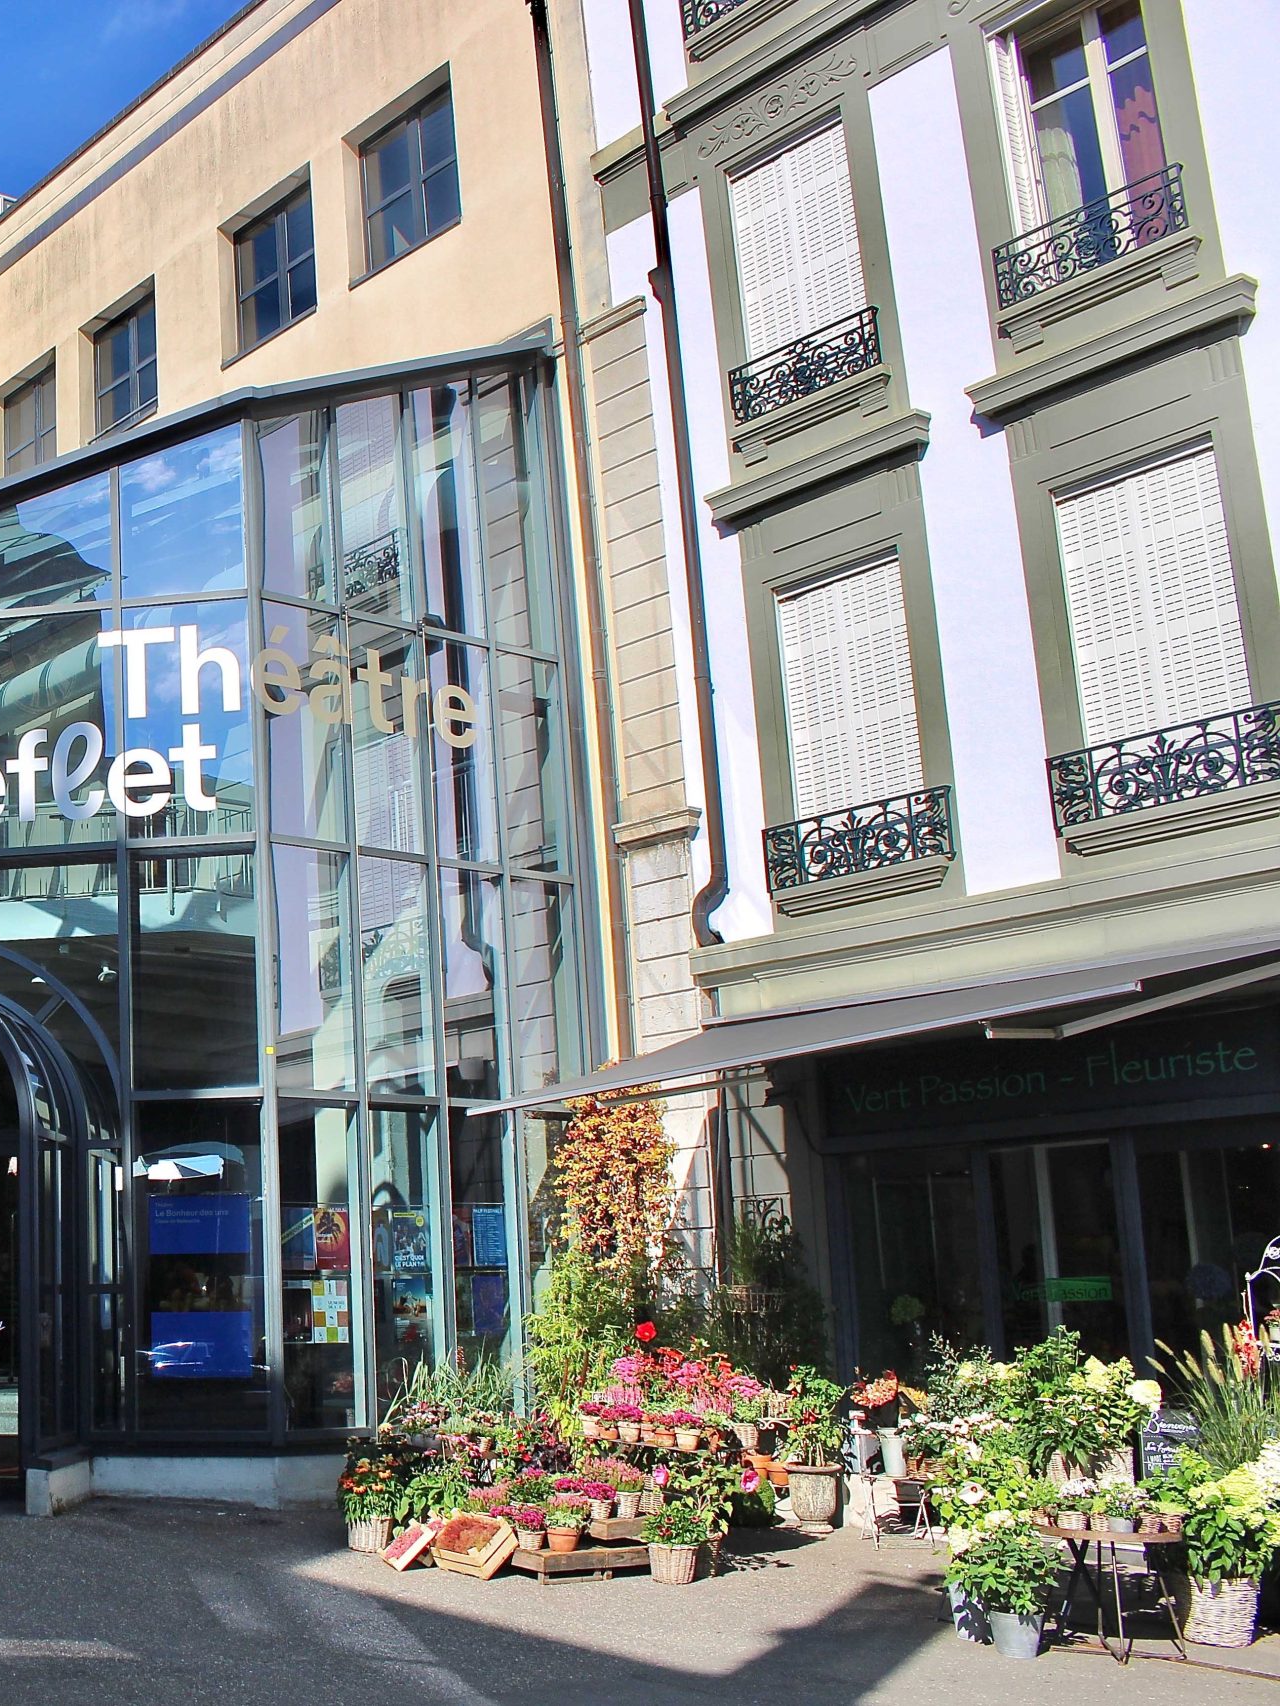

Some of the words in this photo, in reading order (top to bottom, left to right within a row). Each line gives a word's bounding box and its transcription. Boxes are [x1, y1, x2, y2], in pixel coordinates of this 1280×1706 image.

[98, 624, 478, 748] Théâtre
[846, 1080, 910, 1113] Vert
[920, 1066, 1046, 1106] Passion
[1086, 1040, 1258, 1087] Fleuriste
[155, 1209, 165, 1217] Le
[166, 1209, 198, 1217] Bonheur
